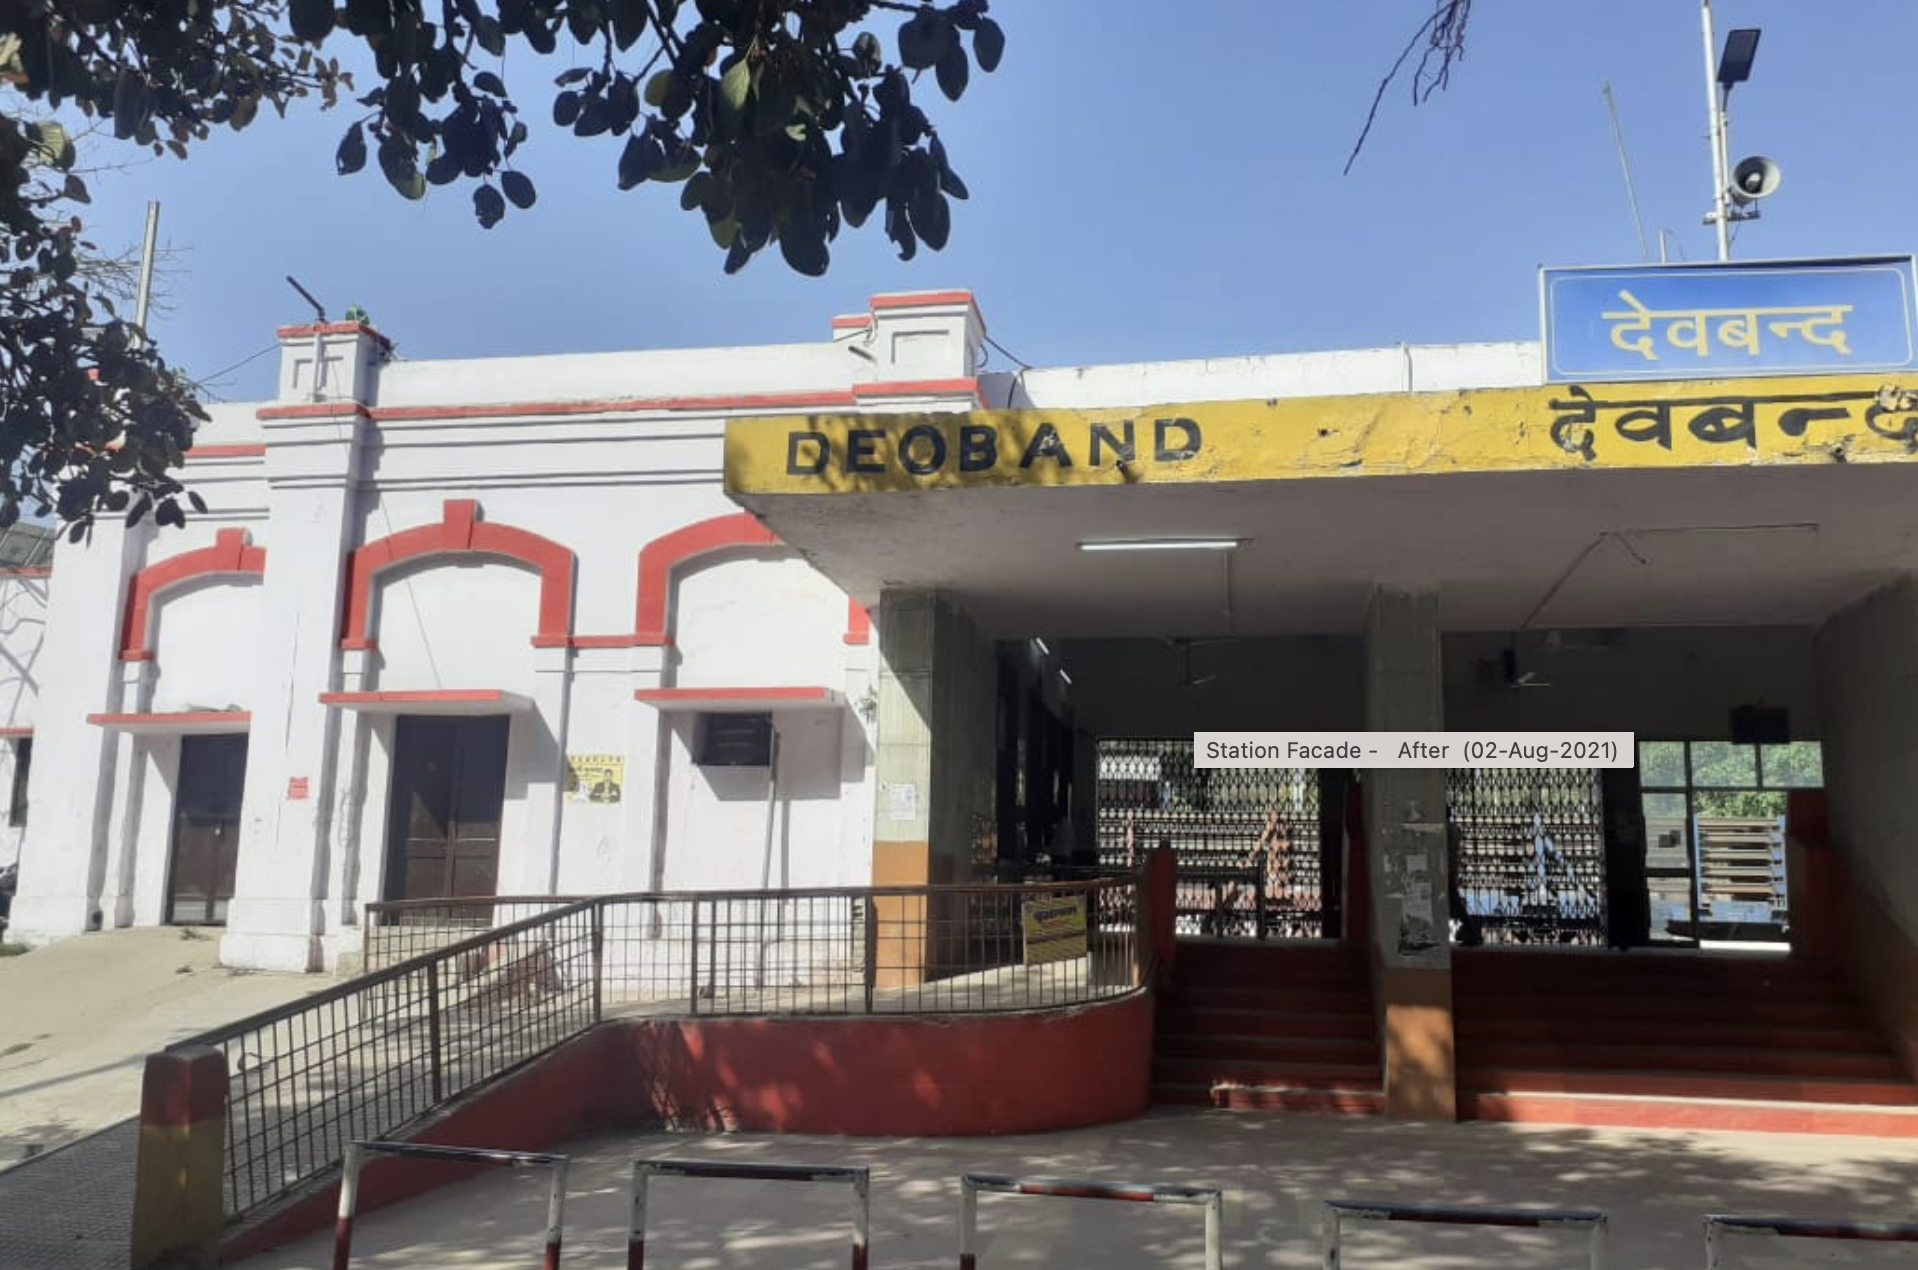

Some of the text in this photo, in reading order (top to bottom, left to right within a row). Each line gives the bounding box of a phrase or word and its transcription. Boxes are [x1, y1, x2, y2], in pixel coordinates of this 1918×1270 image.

[1602, 289, 1855, 360] देवबन्द
[786, 416, 1204, 476] DEOBAND
[1548, 385, 1918, 460] देवबन्द
